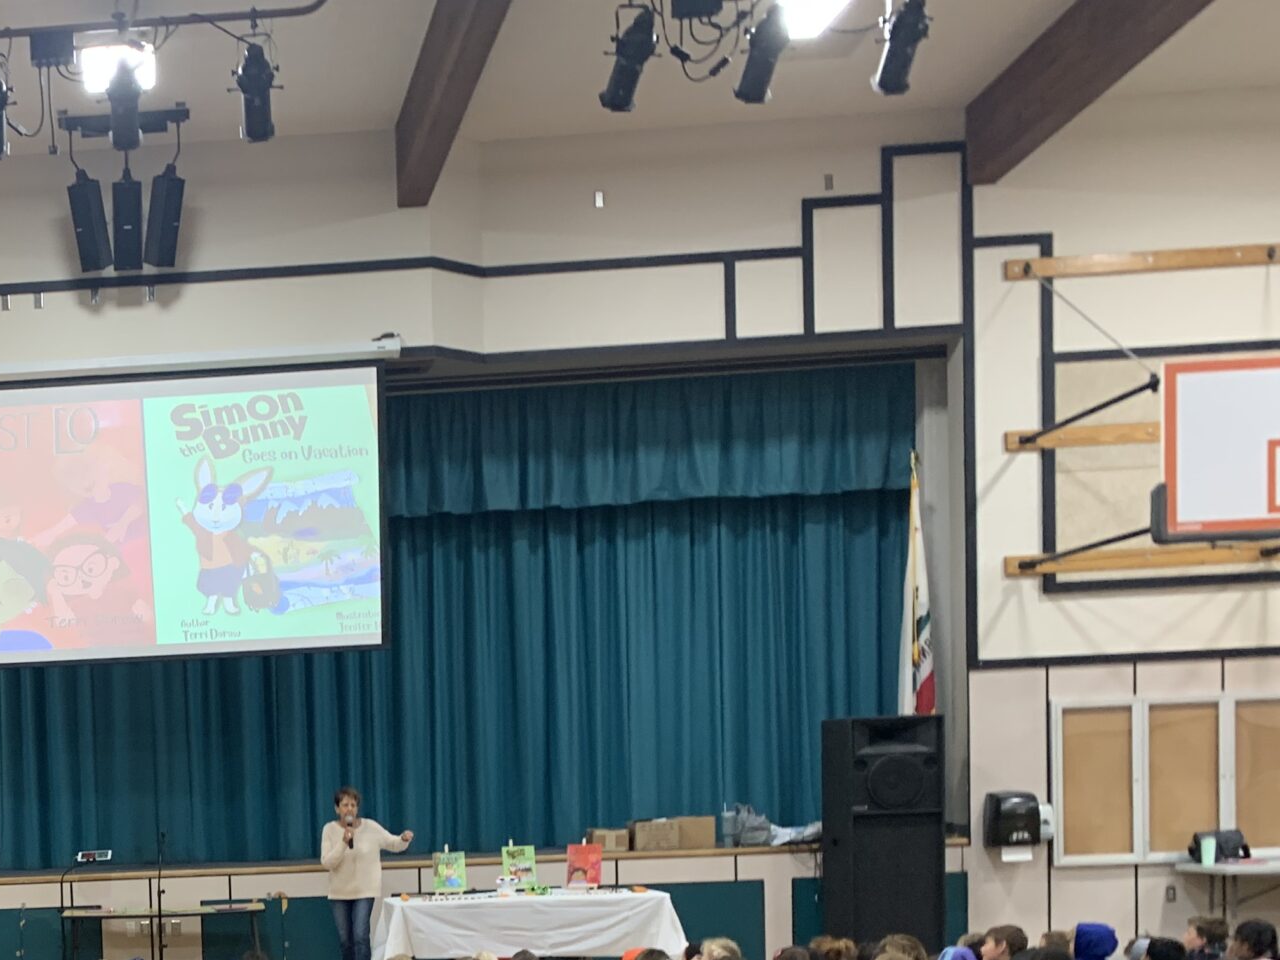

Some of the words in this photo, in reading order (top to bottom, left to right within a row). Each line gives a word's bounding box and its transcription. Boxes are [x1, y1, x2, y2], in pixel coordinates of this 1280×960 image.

[170, 391, 304, 441] Simon
[179, 442, 206, 458] the
[202, 415, 308, 460] Bunny
[241, 447, 277, 464] Goes
[280, 449, 299, 461] on
[300, 444, 369, 462] Vacation
[182, 629, 208, 641] Terri
